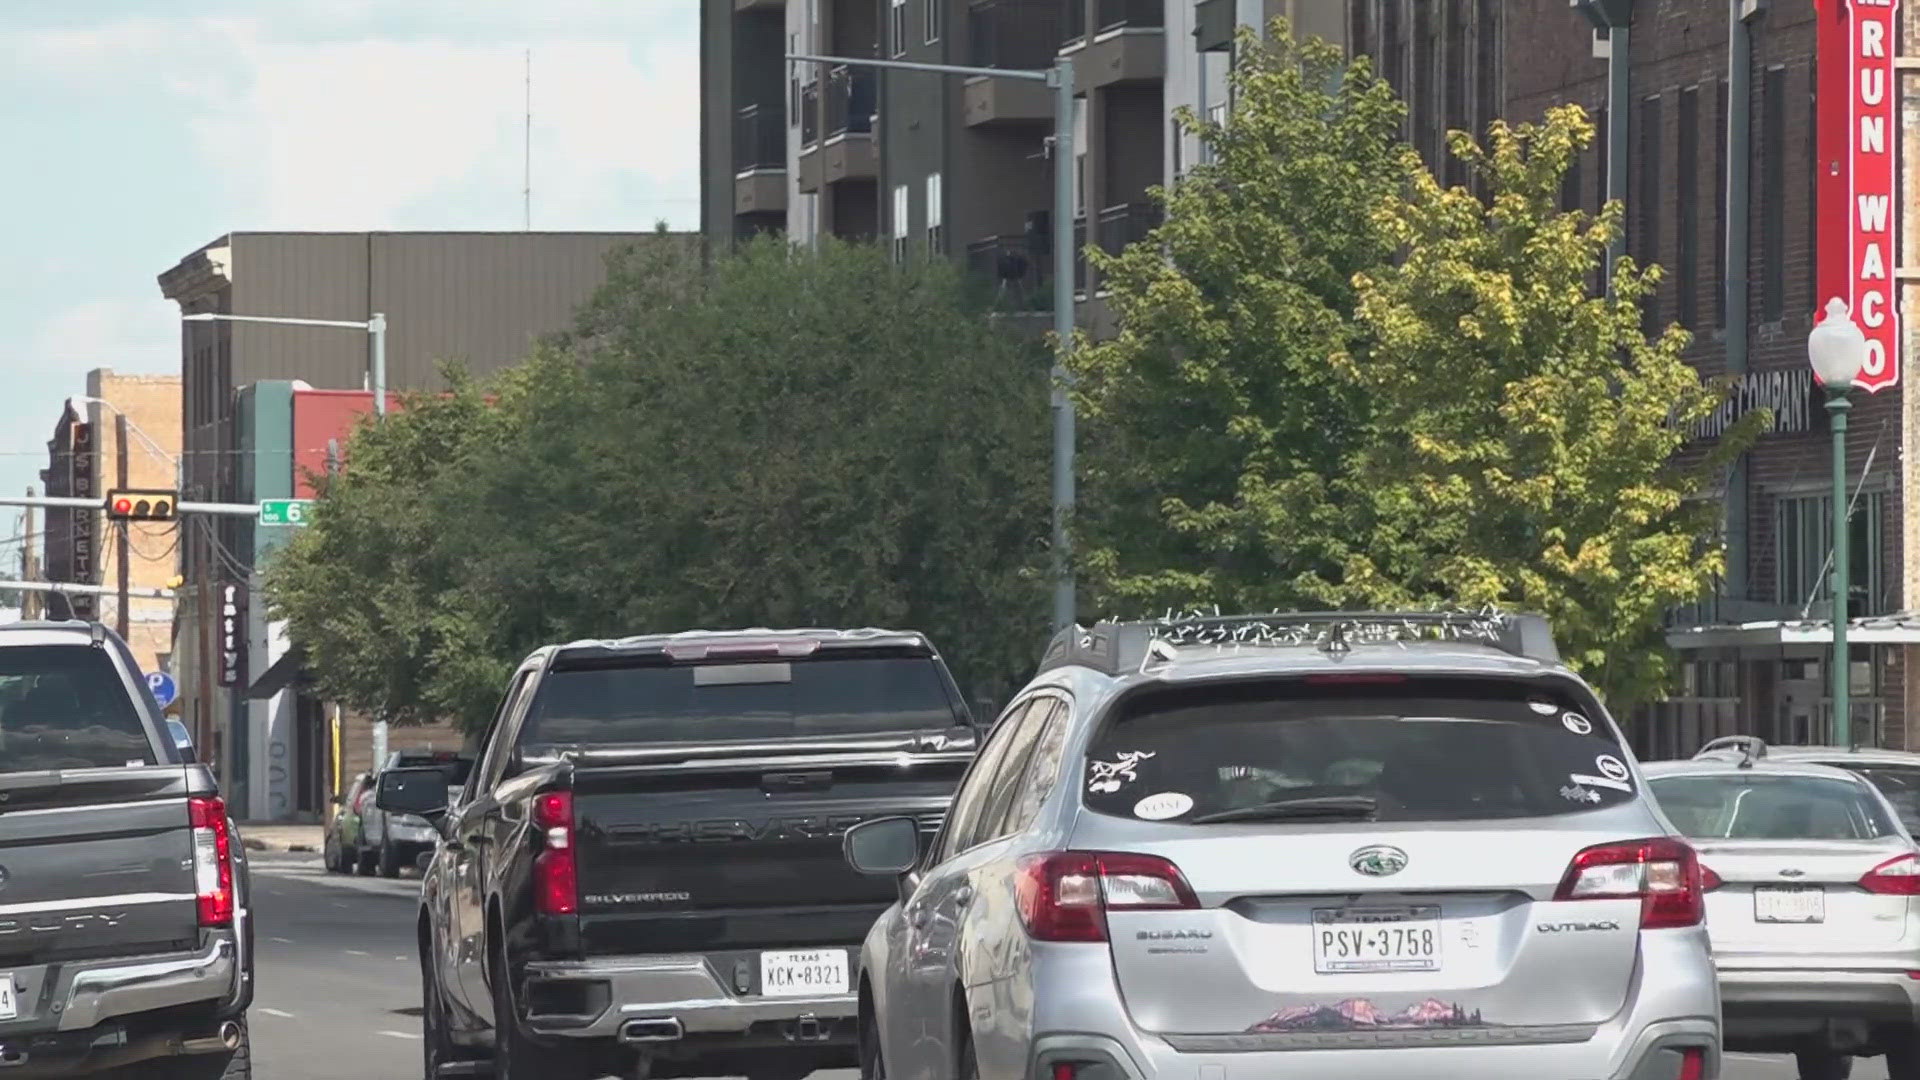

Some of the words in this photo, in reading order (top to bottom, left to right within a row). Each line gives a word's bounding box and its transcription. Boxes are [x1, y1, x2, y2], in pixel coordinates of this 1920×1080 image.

[1861, 19, 1884, 154] RUN
[1857, 194, 1889, 377] WACO
[1738, 368, 1812, 434] COMPANY
[286, 502, 301, 521] 6
[583, 892, 691, 904] SILVERADO
[1536, 921, 1620, 933] OUTBACK
[788, 953, 821, 963] TEXAS
